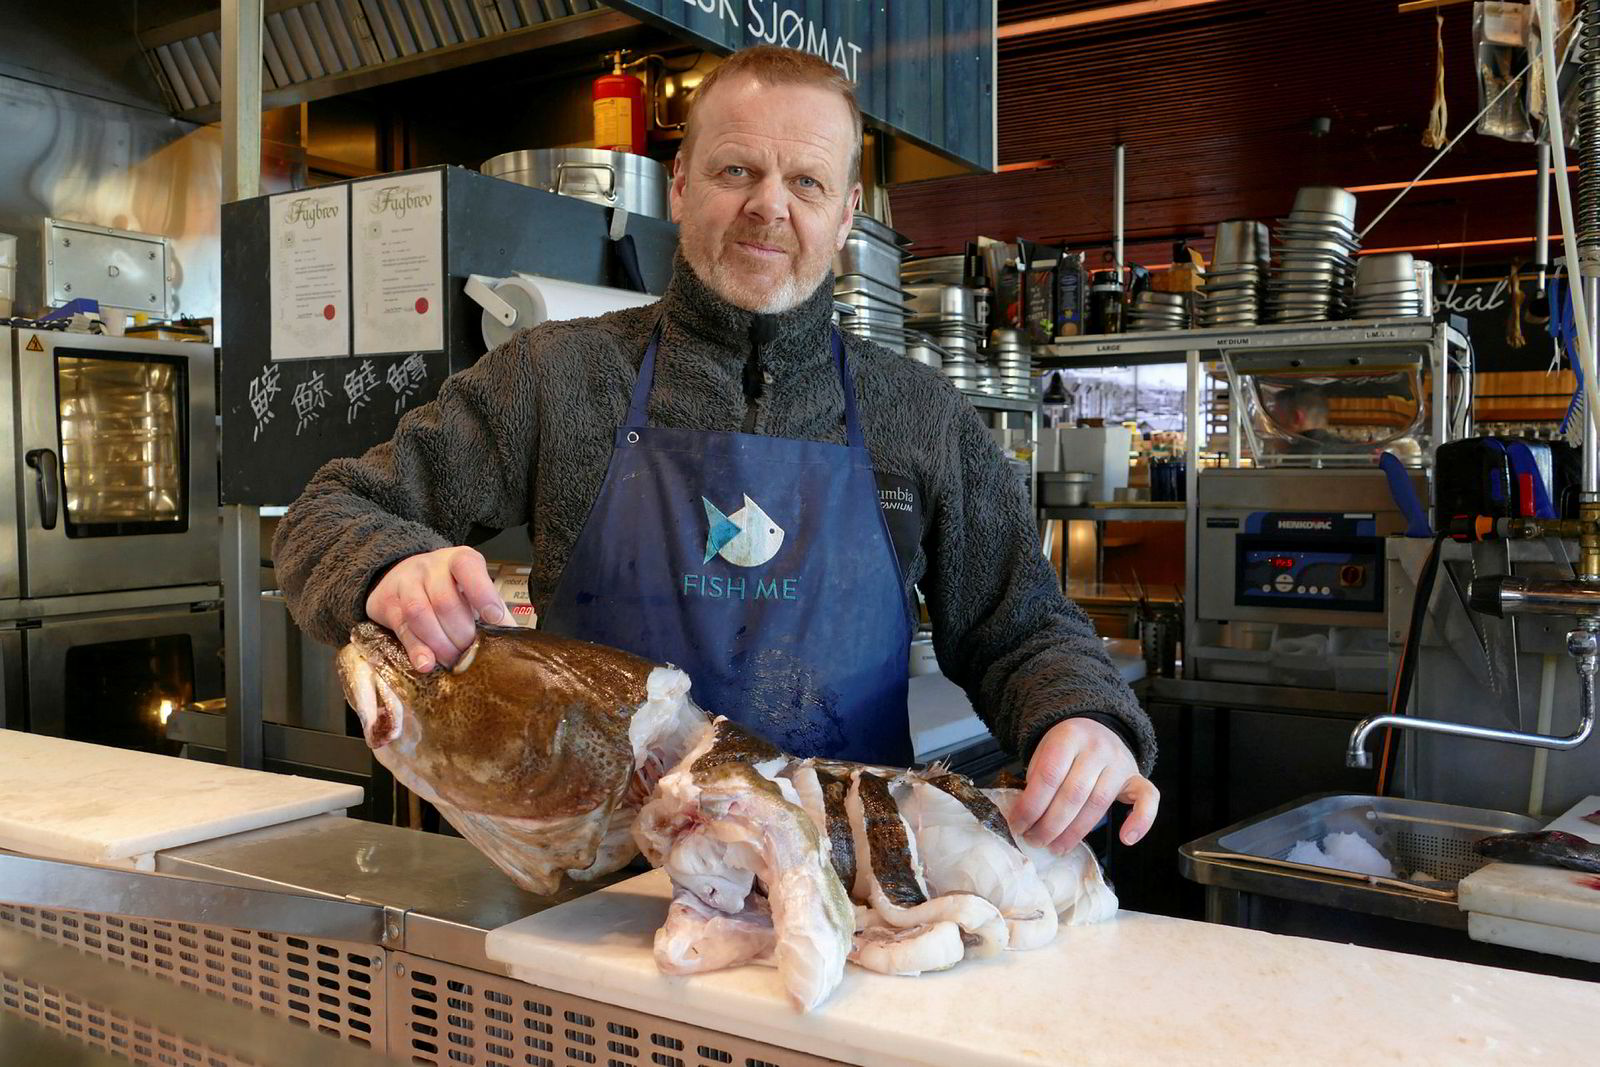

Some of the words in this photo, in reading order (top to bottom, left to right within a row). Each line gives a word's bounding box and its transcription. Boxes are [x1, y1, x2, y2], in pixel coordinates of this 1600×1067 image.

[748, 0, 862, 84] SJØMAT
[1217, 338, 1249, 346] MEDIUM
[1097, 344, 1121, 352] LARGE
[877, 487, 914, 502] umbia
[880, 501, 913, 512] TANIUM
[1278, 520, 1332, 530] HENKOVAC
[683, 574, 745, 600] FISH
[755, 578, 799, 600] ME
